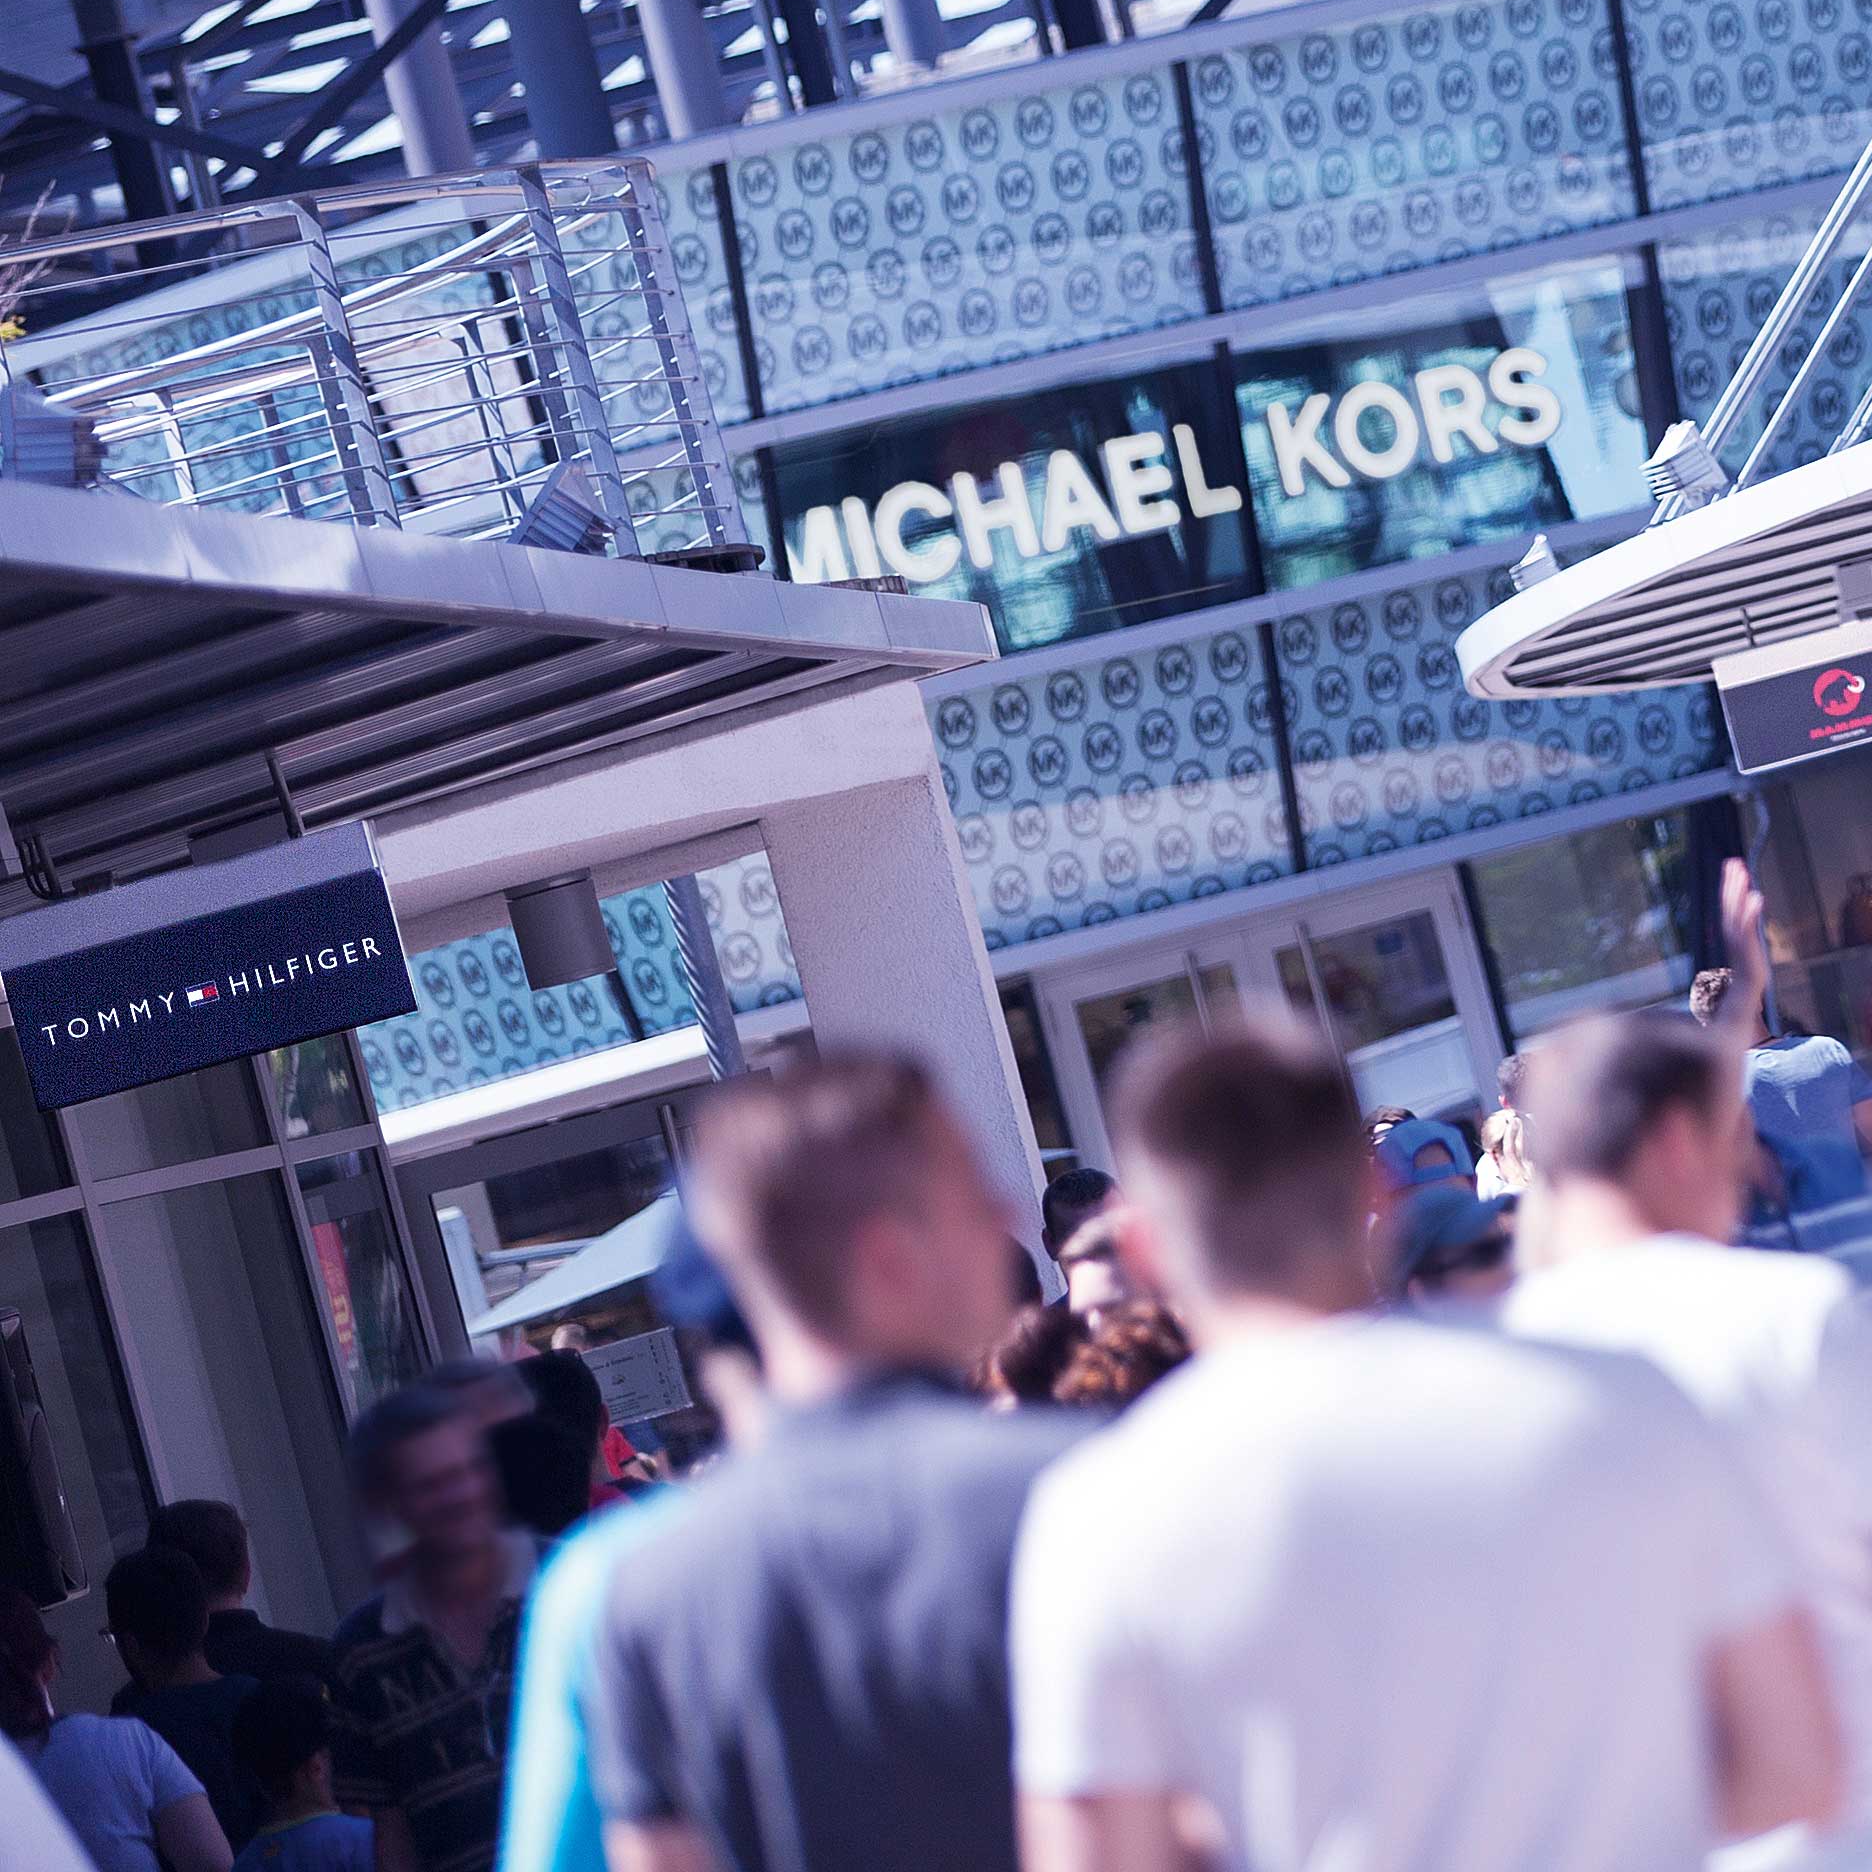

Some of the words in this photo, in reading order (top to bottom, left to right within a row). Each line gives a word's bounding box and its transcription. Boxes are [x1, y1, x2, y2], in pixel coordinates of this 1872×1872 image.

[785, 425, 1242, 584] MICHAEL
[1266, 345, 1562, 497] KORS
[41, 991, 174, 1046] TOMMY
[228, 937, 382, 997] HILFIGER
